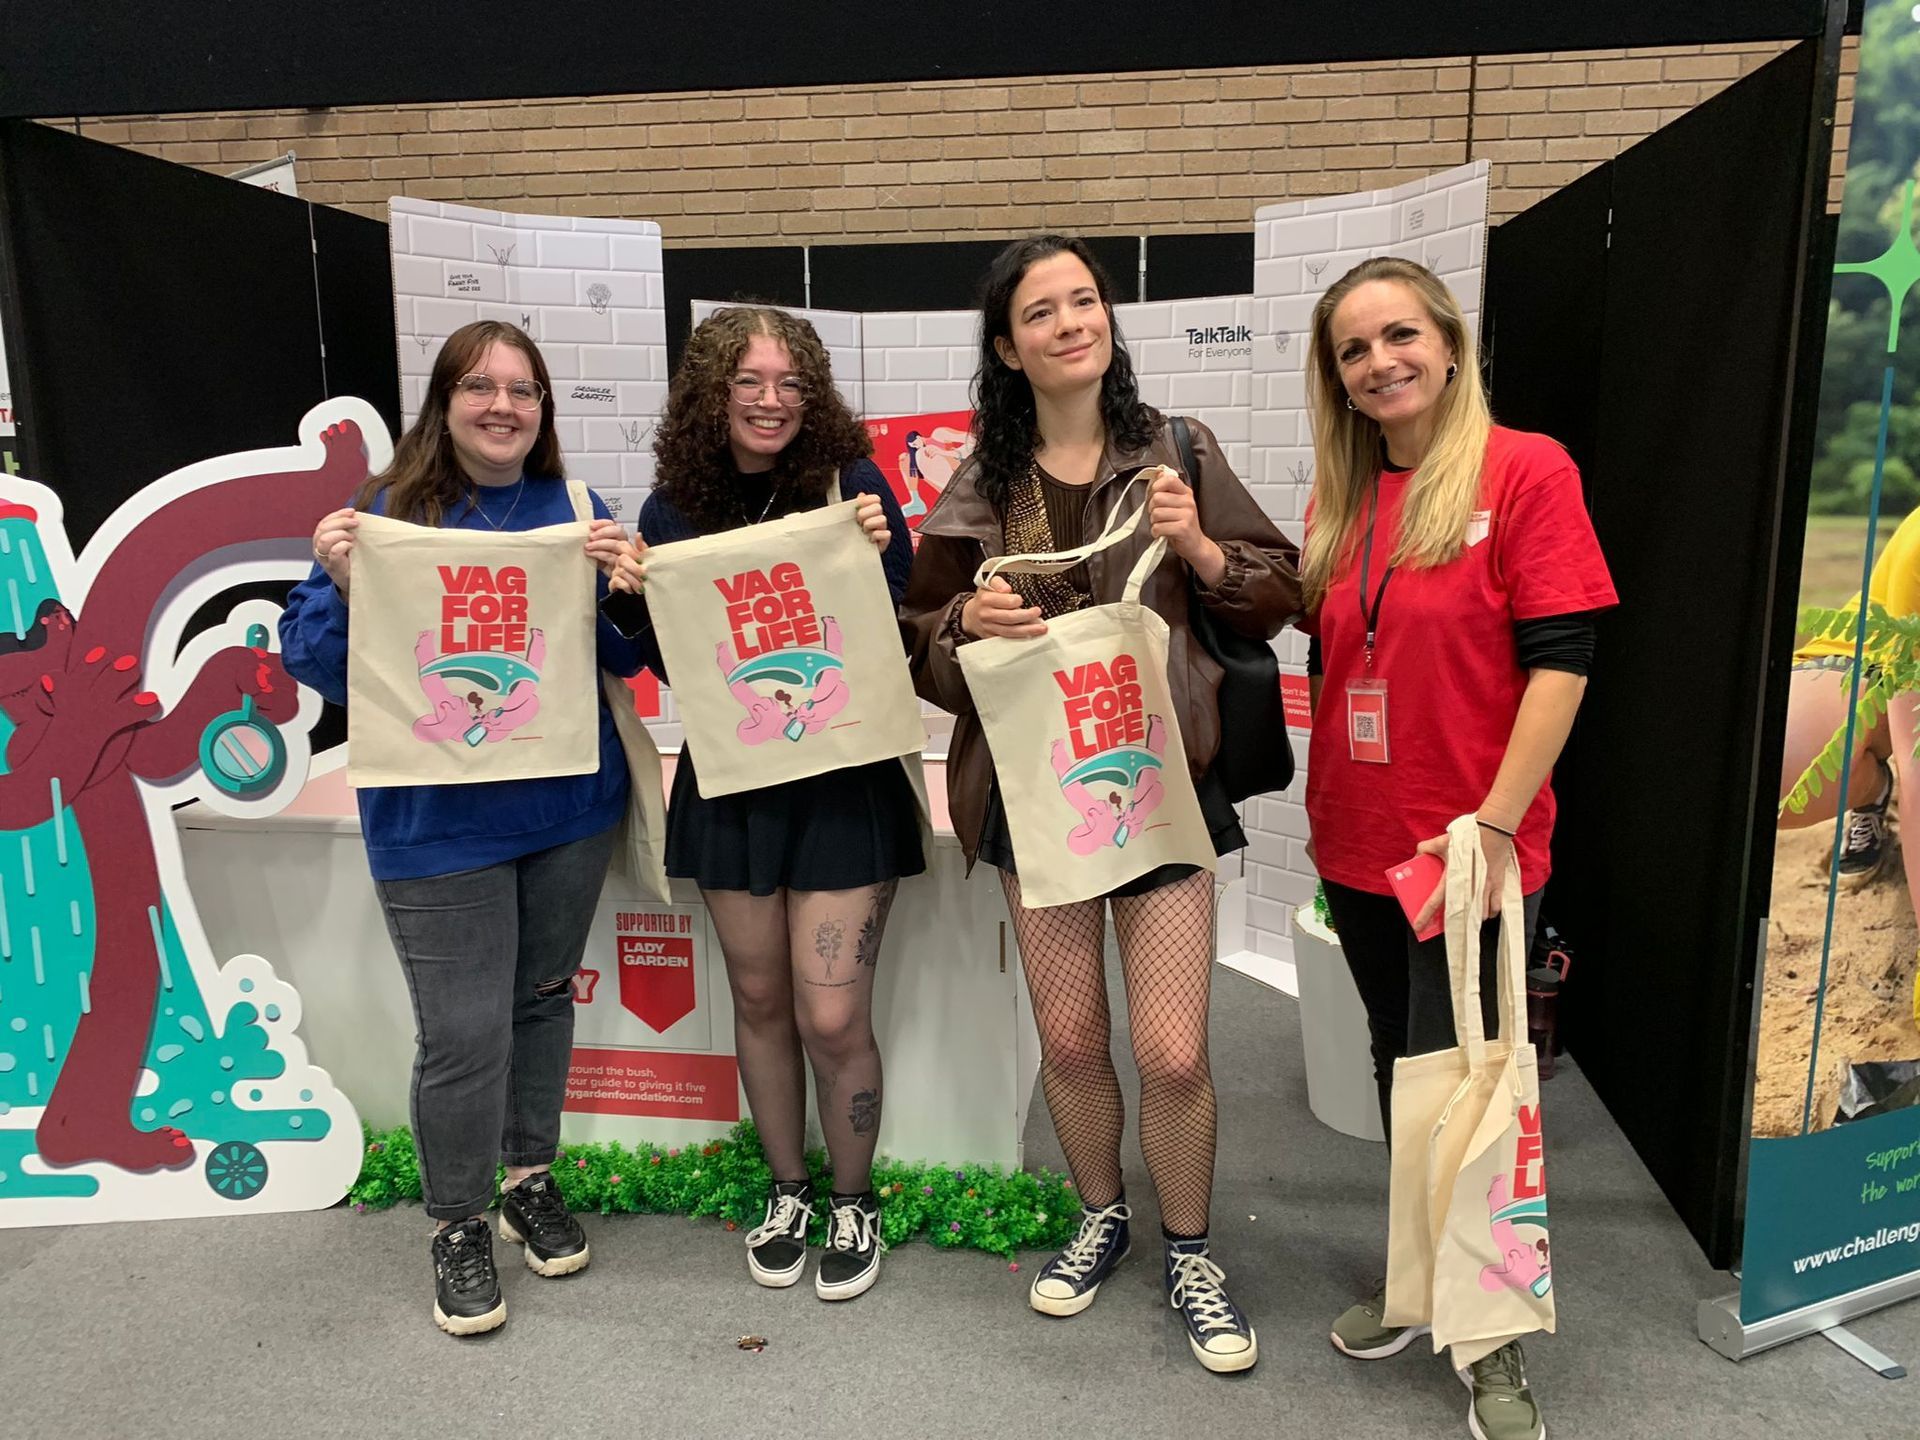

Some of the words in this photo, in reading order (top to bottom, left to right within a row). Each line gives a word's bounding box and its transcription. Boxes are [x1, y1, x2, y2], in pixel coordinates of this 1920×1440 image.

[1185, 325, 1252, 345] TalkTalk
[1188, 348, 1204, 358] For
[1206, 346, 1252, 358] Everyone
[437, 565, 528, 595] VAG
[712, 561, 805, 605] VAG
[441, 595, 529, 624] FOR
[726, 588, 816, 633] FOR
[441, 623, 526, 654] LIFE
[732, 614, 822, 661] LIFE
[1052, 653, 1138, 699] VAG
[1063, 682, 1144, 729] FOR
[1069, 710, 1145, 760] LIFE
[616, 912, 676, 933] SUPPORTED
[679, 915, 692, 933] BY
[623, 942, 665, 954] LADY
[623, 955, 689, 968] GARDEN
[568, 1065, 603, 1075] round
[606, 1066, 624, 1076] the
[626, 1067, 657, 1079] bush,
[590, 1078, 622, 1089] guide
[624, 1079, 636, 1089] to
[639, 1080, 672, 1093] giving
[675, 1081, 683, 1092] it
[685, 1081, 706, 1093] five
[1861, 1180, 1888, 1204] the
[1793, 1222, 1920, 1274] www.challeng
